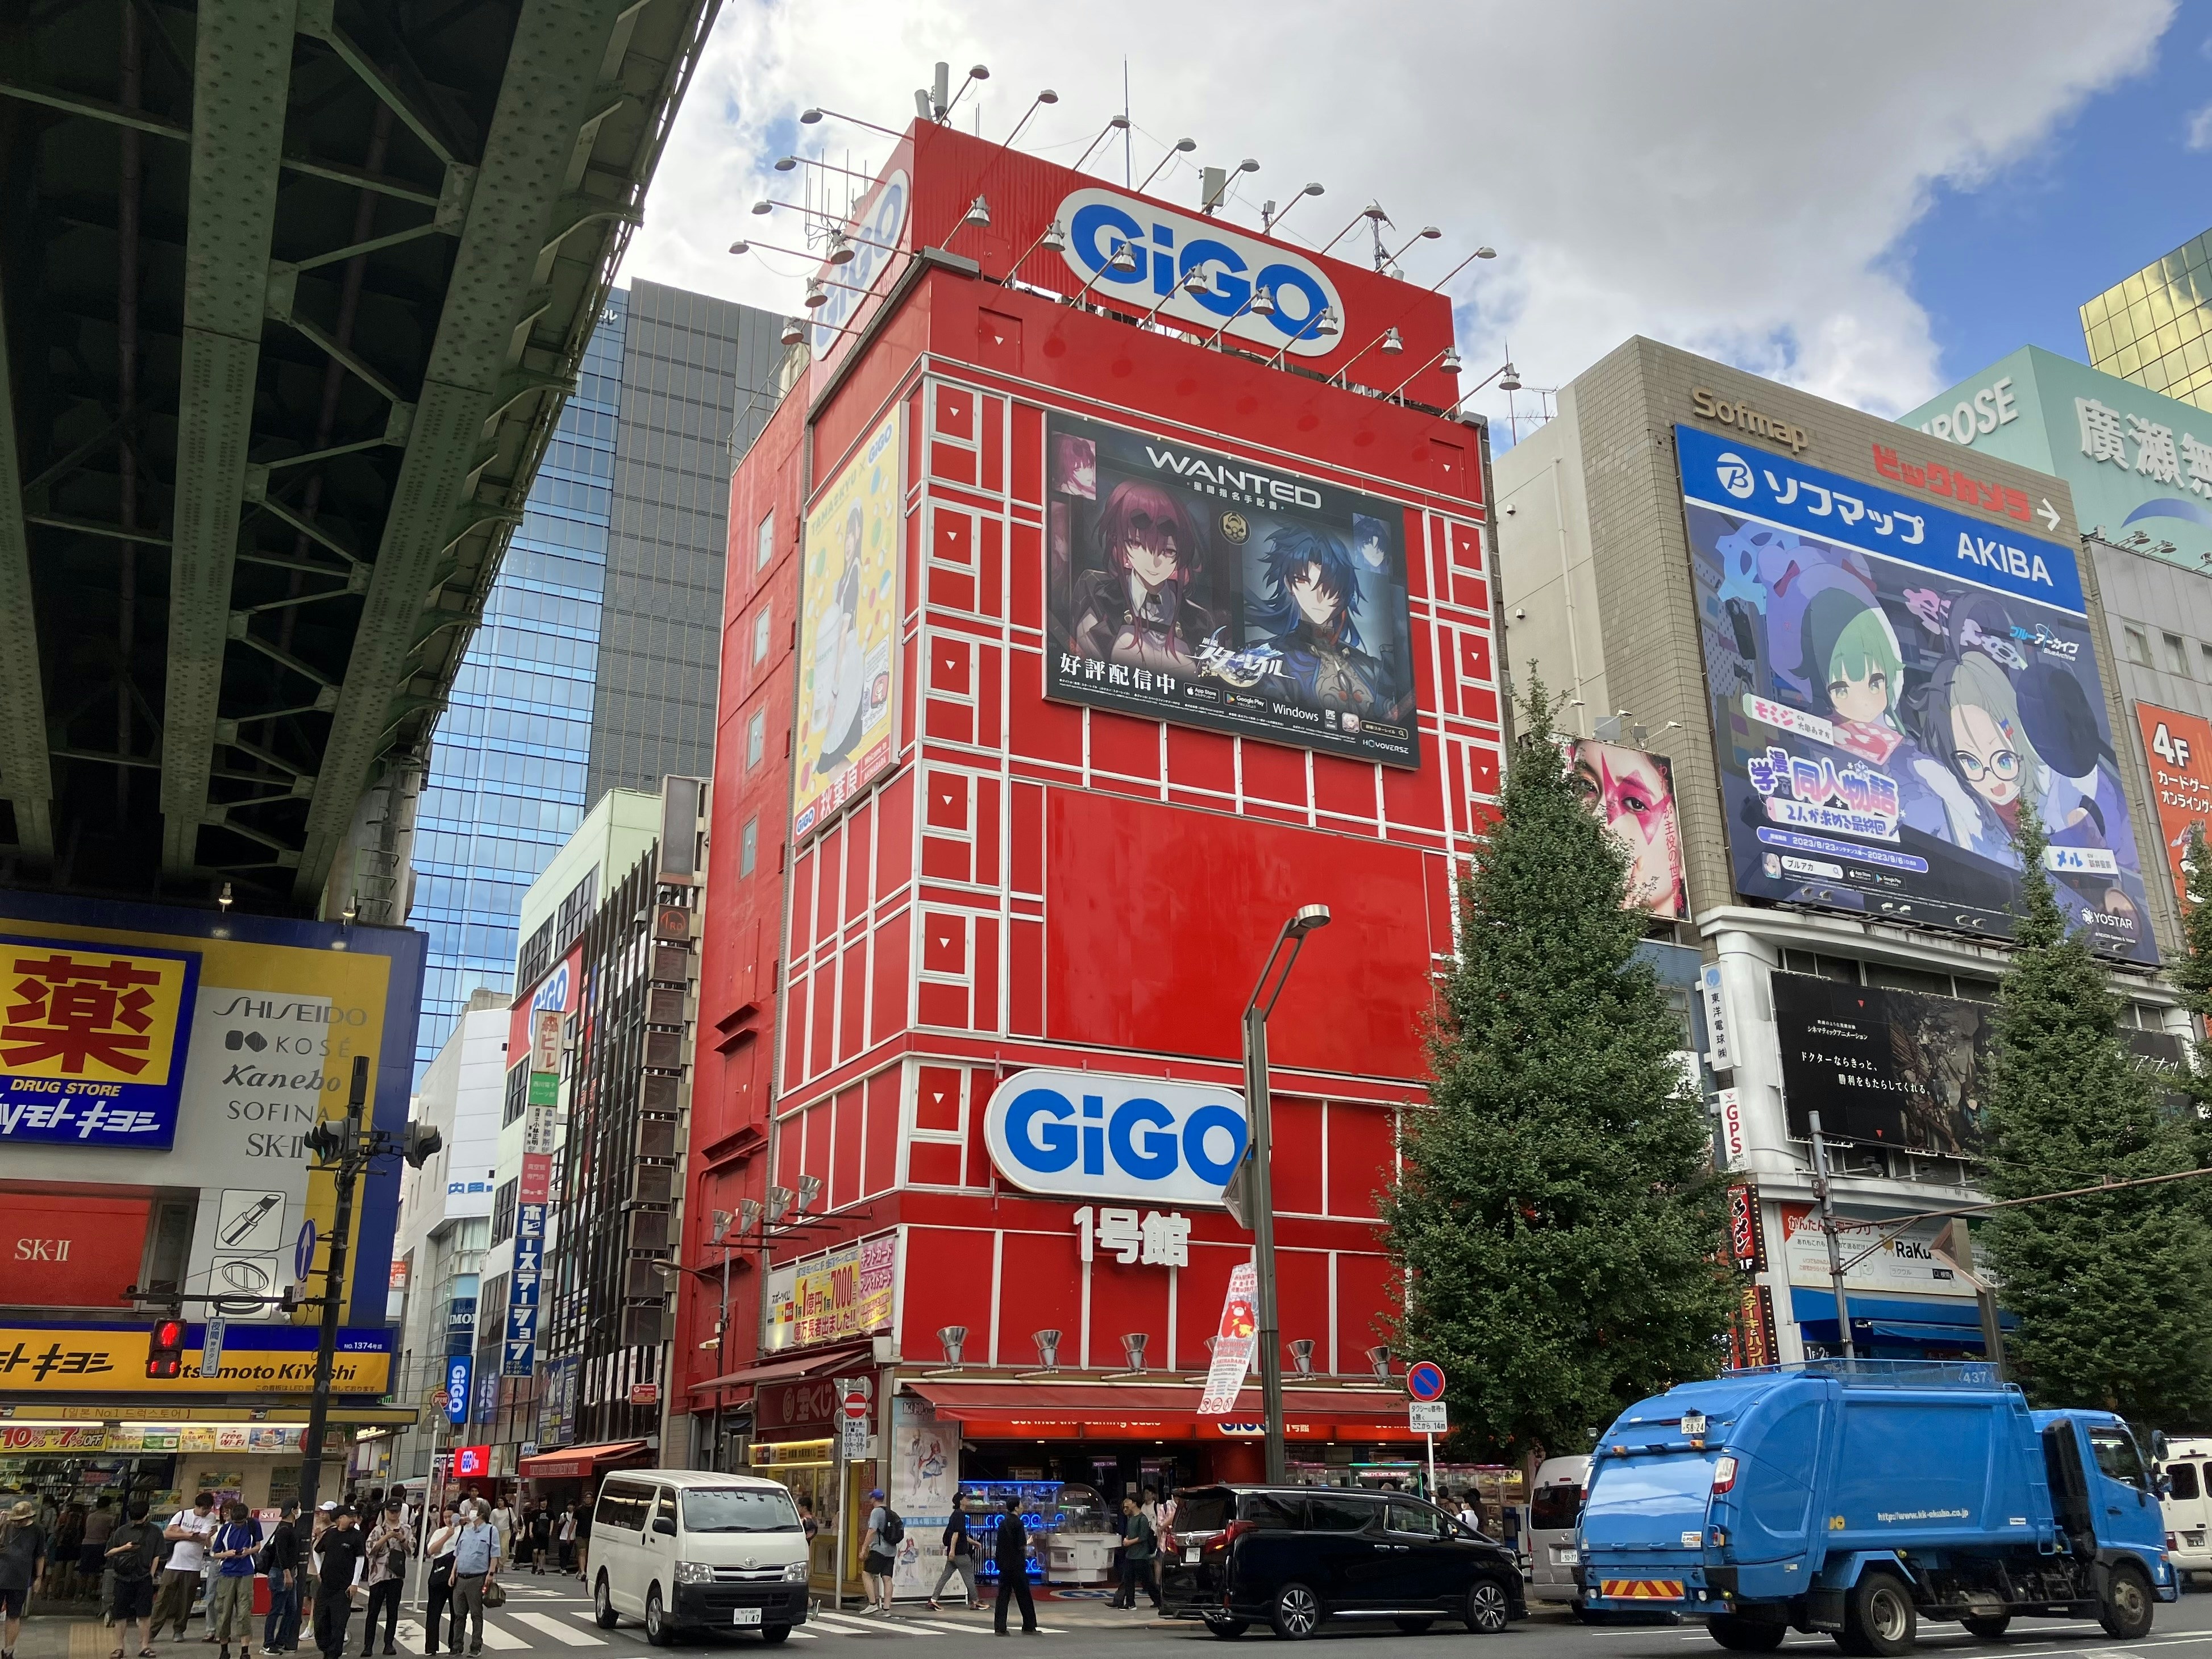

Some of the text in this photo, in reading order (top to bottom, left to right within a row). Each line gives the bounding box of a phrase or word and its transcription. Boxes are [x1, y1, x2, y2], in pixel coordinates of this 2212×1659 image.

[816, 183, 902, 348] GiGO
[1071, 204, 1330, 340] GiGO
[1692, 386, 1810, 455] Sofmap
[1920, 376, 2019, 446] ROSE
[868, 423, 892, 464] GiGO
[1145, 446, 1321, 509] WANTED
[1873, 443, 2032, 522] ビックカメラ
[1764, 470, 2055, 588] ソフマップ AKIBA
[1060, 652, 1176, 695] 好評配信中
[1236, 695, 1265, 708] Google Play
[1273, 702, 1320, 723] Windows
[1754, 700, 1794, 726] モミジ
[2153, 724, 2189, 767] 4F
[863, 755, 887, 781] AKIHABARA
[2157, 770, 2210, 792] カードゲー
[820, 762, 858, 820] 秋葉原
[2161, 789, 2212, 813] オンラインゲ
[797, 809, 814, 834] GiGO
[1786, 804, 1886, 836] 2人が求める最終回
[1659, 764, 1685, 913] わたが主役の世界線。
[1787, 859, 1814, 872] ブルアカ
[2057, 850, 2082, 867] メル
[2093, 912, 2133, 930] YOSTAR
[0, 955, 161, 1075] 薬
[213, 996, 368, 1025] SHISEIDO
[276, 1035, 350, 1058] KOSÉ
[1801, 1051, 1877, 1072] ドクターならきっと、
[11, 1079, 122, 1097] DRUG STORE
[222, 1063, 341, 1093] Kanebo
[1837, 1073, 1931, 1096] 勝利をもたらしてくれる。
[227, 1100, 330, 1124] SOFINA
[1005, 1088, 1253, 1186] GiGO
[1726, 1104, 1742, 1154] GPS
[246, 1133, 305, 1159] SK-II
[15, 1237, 72, 1262] SK-II
[1074, 1205, 1191, 1267] 1号館
[1895, 1241, 1932, 1260] RaKu
[1739, 1258, 1753, 1270] 1F
[510, 1205, 542, 1361] ホビーステーション
[449, 1313, 475, 1325] IMO
[177, 1364, 274, 1381] tsmoto
[448, 1365, 466, 1413] GiGO
[797, 1383, 841, 1421] 宝くじ
